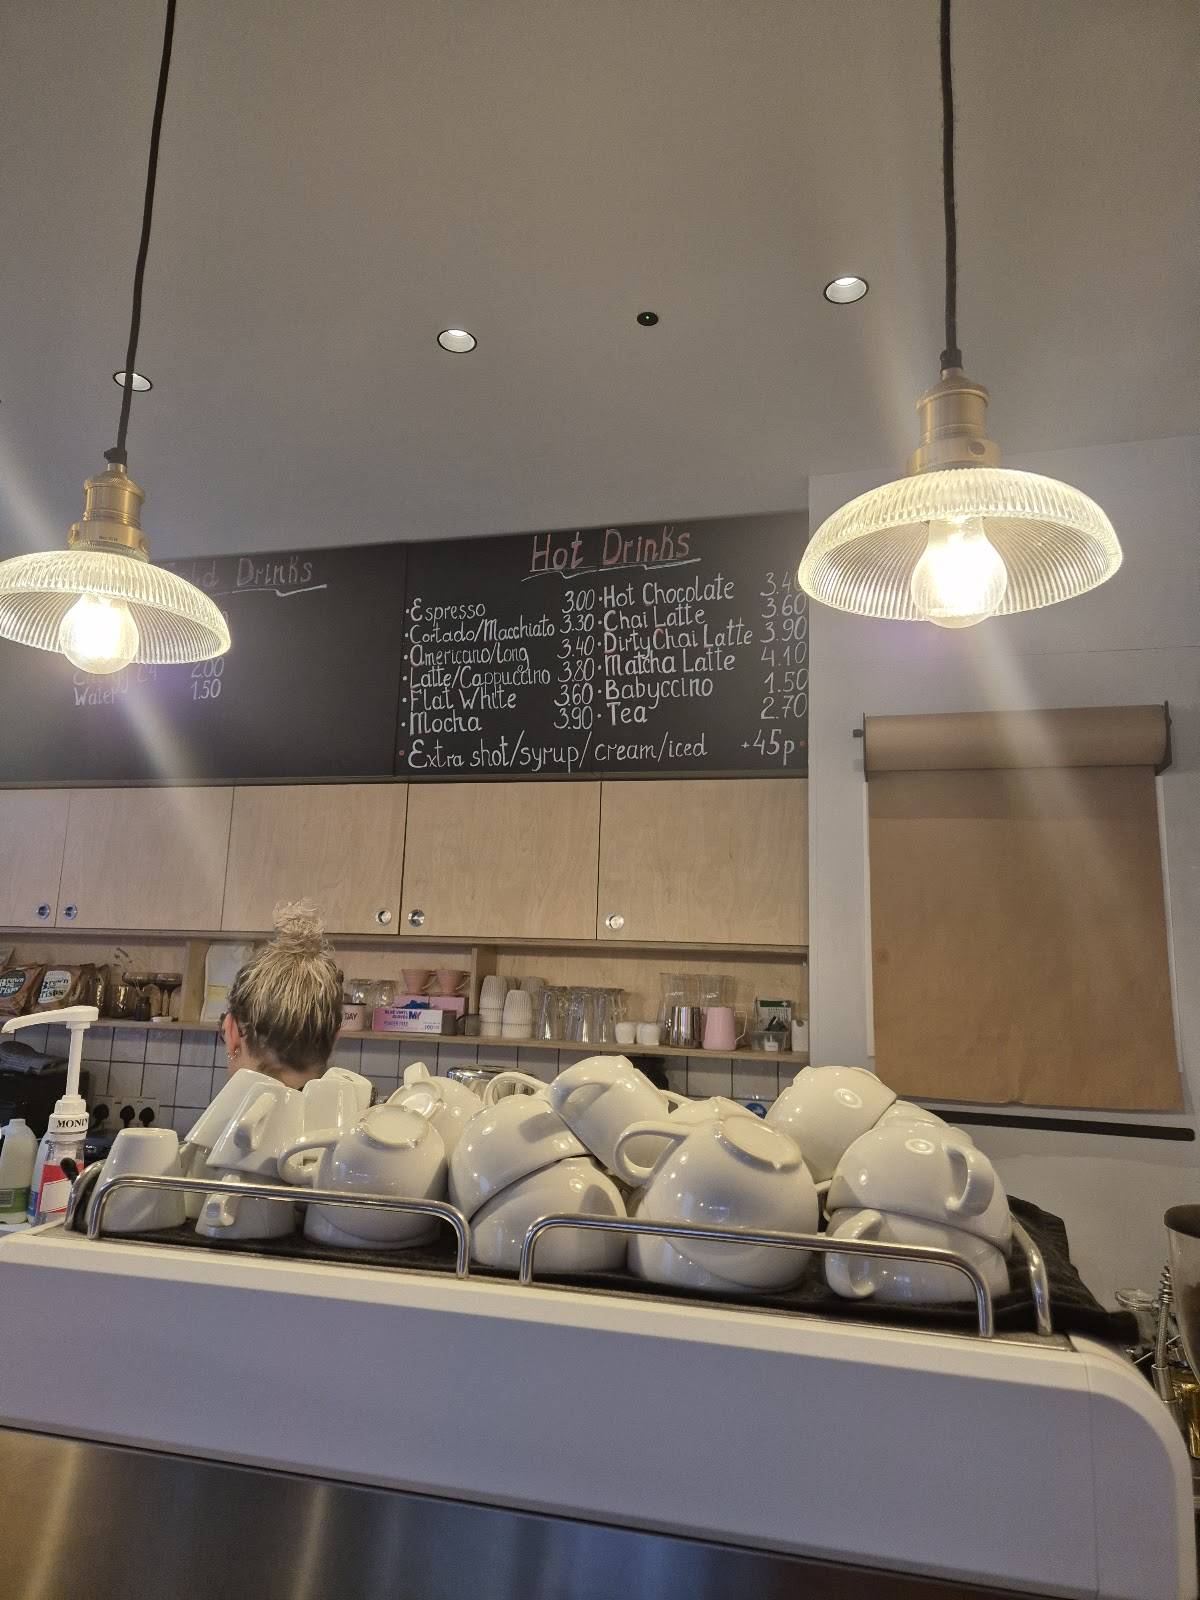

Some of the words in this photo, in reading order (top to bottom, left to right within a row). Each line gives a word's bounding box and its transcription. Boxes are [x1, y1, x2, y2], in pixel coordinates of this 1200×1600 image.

[531, 531, 584, 572] Hot
[603, 526, 690, 565] Drinks
[237, 556, 313, 586] Drinks
[410, 598, 486, 627] Espresso
[562, 589, 596, 614] 3.00
[603, 583, 635, 608] Hot
[642, 573, 735, 605] Chocolate
[410, 614, 555, 644] Cortado/Macchiato
[560, 614, 595, 634] 3.30
[603, 610, 649, 632] Chai
[654, 604, 706, 629] Latte
[761, 592, 807, 619] 3.60
[557, 635, 595, 659] 3.40
[603, 630, 651, 659] Dirty
[653, 628, 698, 650] Chai
[703, 617, 753, 649] Latte
[760, 615, 807, 644] 3.90
[605, 649, 676, 677] Matcha
[683, 648, 736, 673] Latte
[761, 642, 807, 668] 4.10
[191, 679, 222, 700] 1.50
[410, 666, 551, 699] Latte/Cappuccino
[557, 657, 595, 683] 3.80
[605, 677, 713, 710] Babyccino
[764, 668, 808, 694] 1.50
[410, 688, 454, 711] Flat
[459, 685, 517, 710] White
[554, 684, 594, 708] 3.60
[607, 702, 648, 726] Tea
[760, 692, 808, 720] 2.70
[410, 709, 482, 736] Mocha
[554, 705, 593, 730] 3.90
[408, 739, 465, 769] Extra
[594, 731, 708, 763] cream/iced
